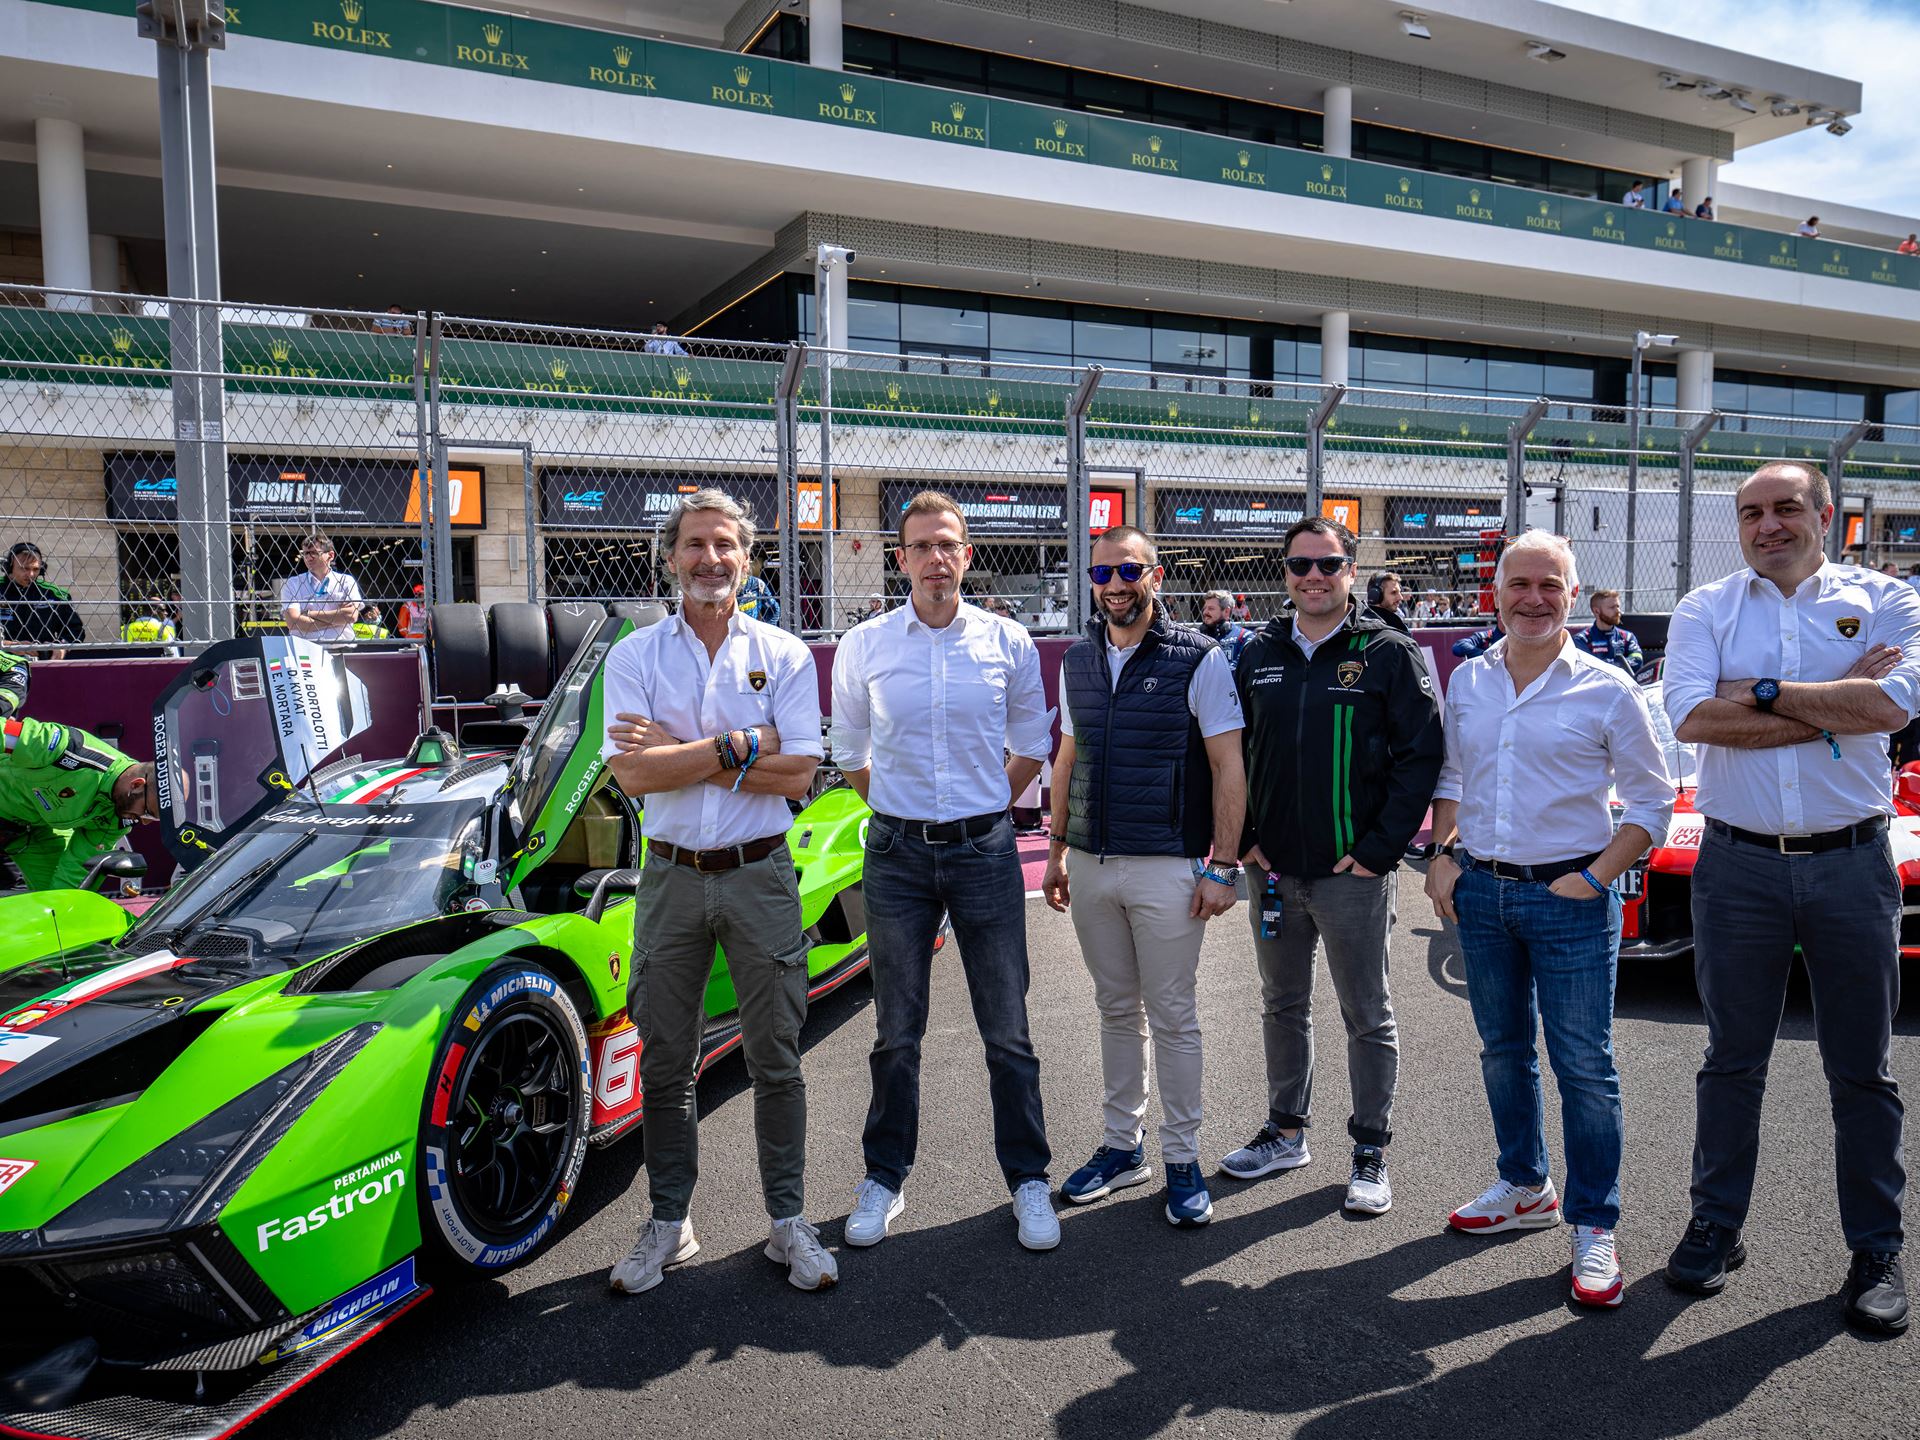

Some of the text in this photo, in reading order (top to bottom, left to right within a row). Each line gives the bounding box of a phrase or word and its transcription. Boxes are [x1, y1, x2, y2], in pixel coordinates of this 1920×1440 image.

[313, 21, 391, 48] ROLEX
[457, 44, 529, 70] ROLEX
[590, 66, 656, 90] ROLEX
[712, 86, 774, 108] ROLEX
[819, 103, 877, 124] ROLEX
[931, 121, 984, 141] ROLEX
[1035, 138, 1085, 156] ROLEX
[1132, 153, 1178, 171] ROLEX
[1222, 168, 1265, 184] ROLEX
[1306, 181, 1346, 197] ROLEX
[1385, 194, 1422, 209] ROLEX
[1456, 205, 1493, 220] ROLEX
[1526, 215, 1560, 231] ROLEX
[1593, 226, 1625, 241] ROLEX
[1655, 236, 1686, 250] ROLEX
[247, 481, 293, 502] IRON
[1090, 499, 1110, 528] 63
[1213, 509, 1247, 522] PROTON
[1435, 515, 1464, 527] PROTON
[1252, 677, 1282, 686] Fastron
[271, 672, 294, 738] E. MORTARA
[288, 679, 306, 715] KVYAT
[301, 669, 329, 750] M. BORTOLOTTI
[153, 714, 171, 810] ROGER DUBUIS
[564, 760, 601, 814] ROGER
[261, 809, 415, 828] Lamborghini
[490, 975, 552, 1008] MICHELIN
[559, 993, 584, 1040] PILOT SPORT
[333, 1150, 402, 1191] PERTAMINA
[256, 1167, 406, 1253] Fastron
[441, 1207, 477, 1255] PILOT SPORT
[482, 1218, 549, 1264] MICHELIN
[312, 1276, 400, 1335] MICHELIN
